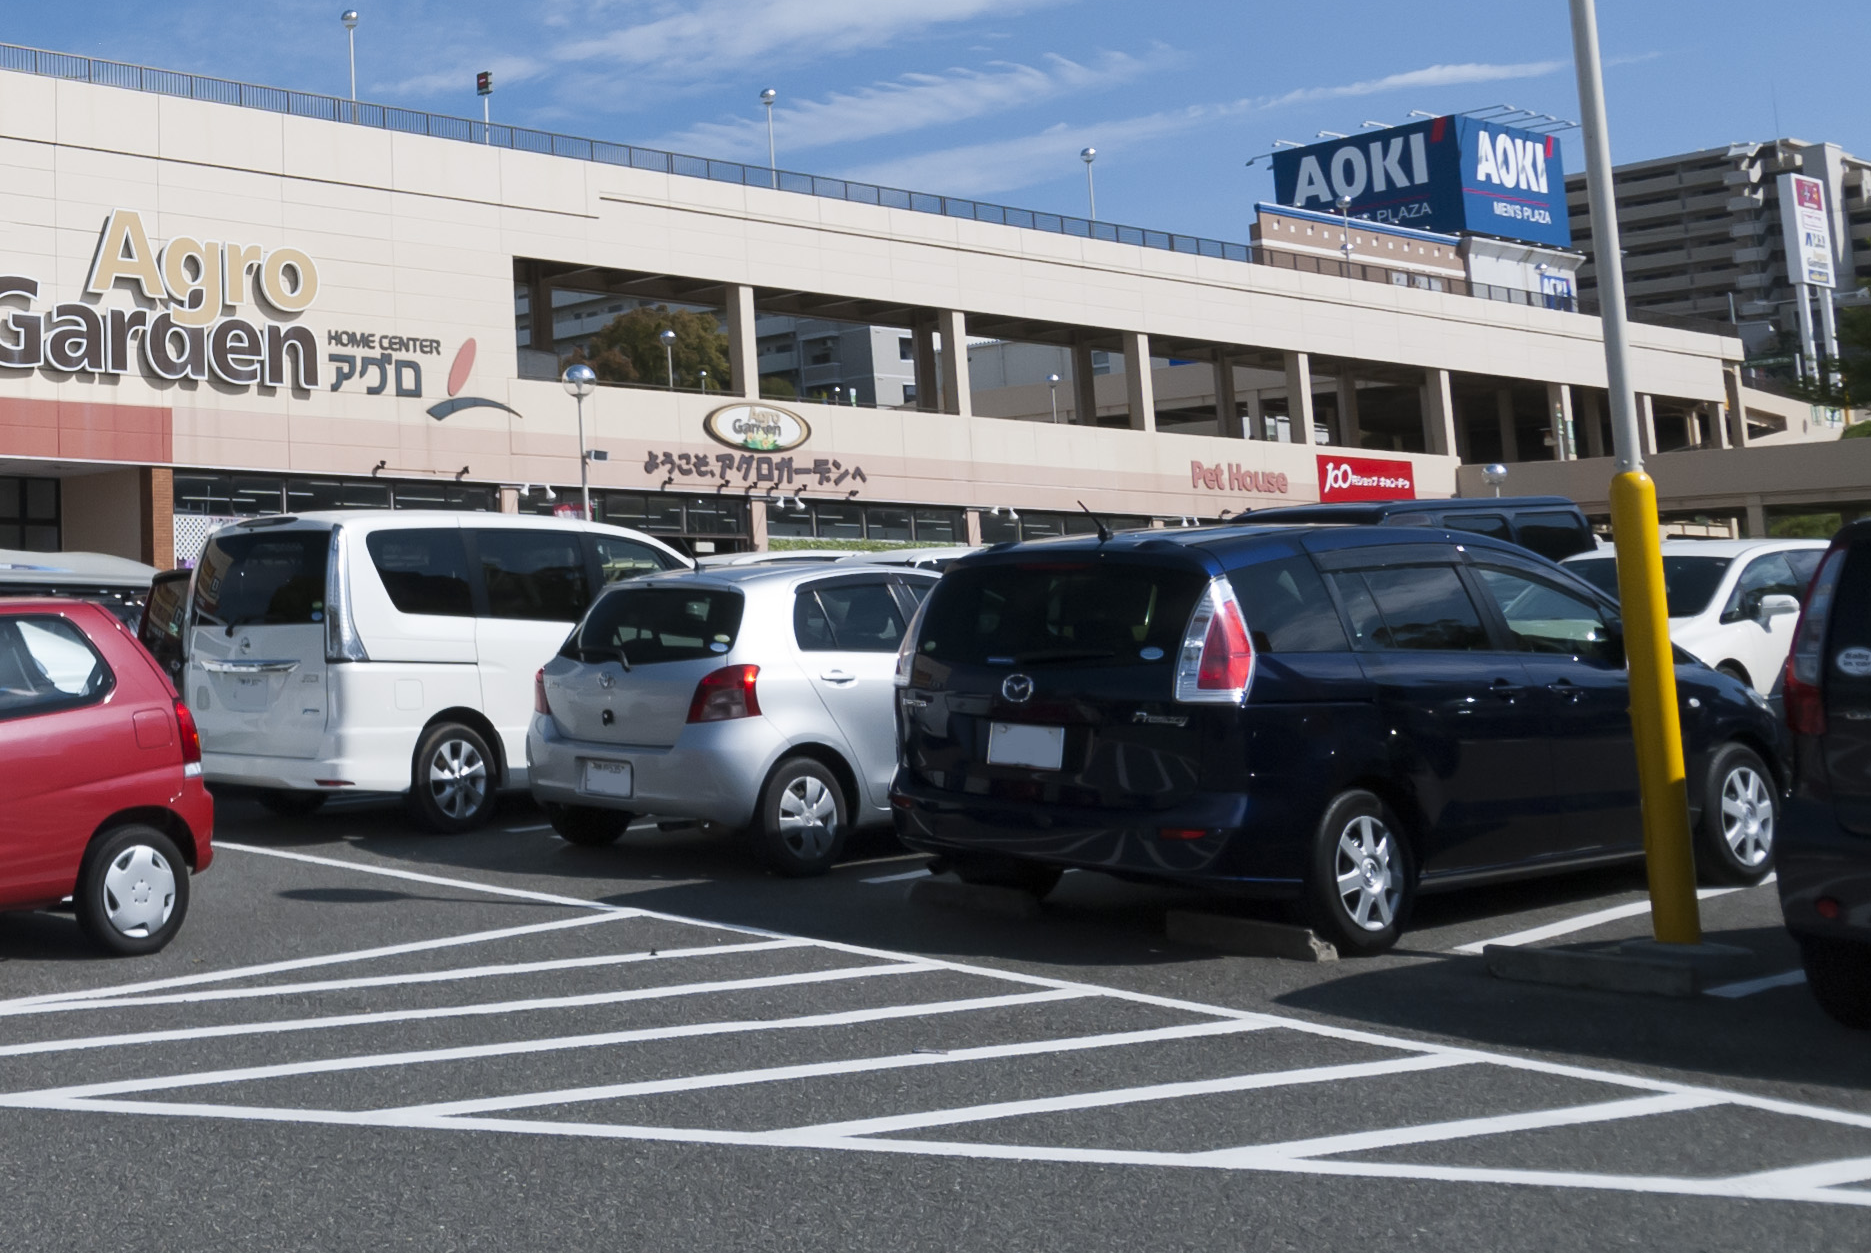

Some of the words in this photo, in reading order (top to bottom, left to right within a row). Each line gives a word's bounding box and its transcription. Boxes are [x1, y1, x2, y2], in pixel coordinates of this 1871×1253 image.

[1293, 132, 1429, 206] AOKI
[1476, 130, 1549, 194] AOKI
[1377, 202, 1432, 223] PLAZA
[1493, 201, 1522, 219] MEN'S
[1523, 206, 1552, 224] PLAZA
[87, 207, 320, 326] Agro
[327, 329, 377, 350] HOME
[379, 334, 441, 355] CENTER
[327, 353, 424, 398] アグロ
[747, 406, 781, 424] Agro
[1191, 460, 1225, 491] Pet
[1227, 463, 1289, 494] House
